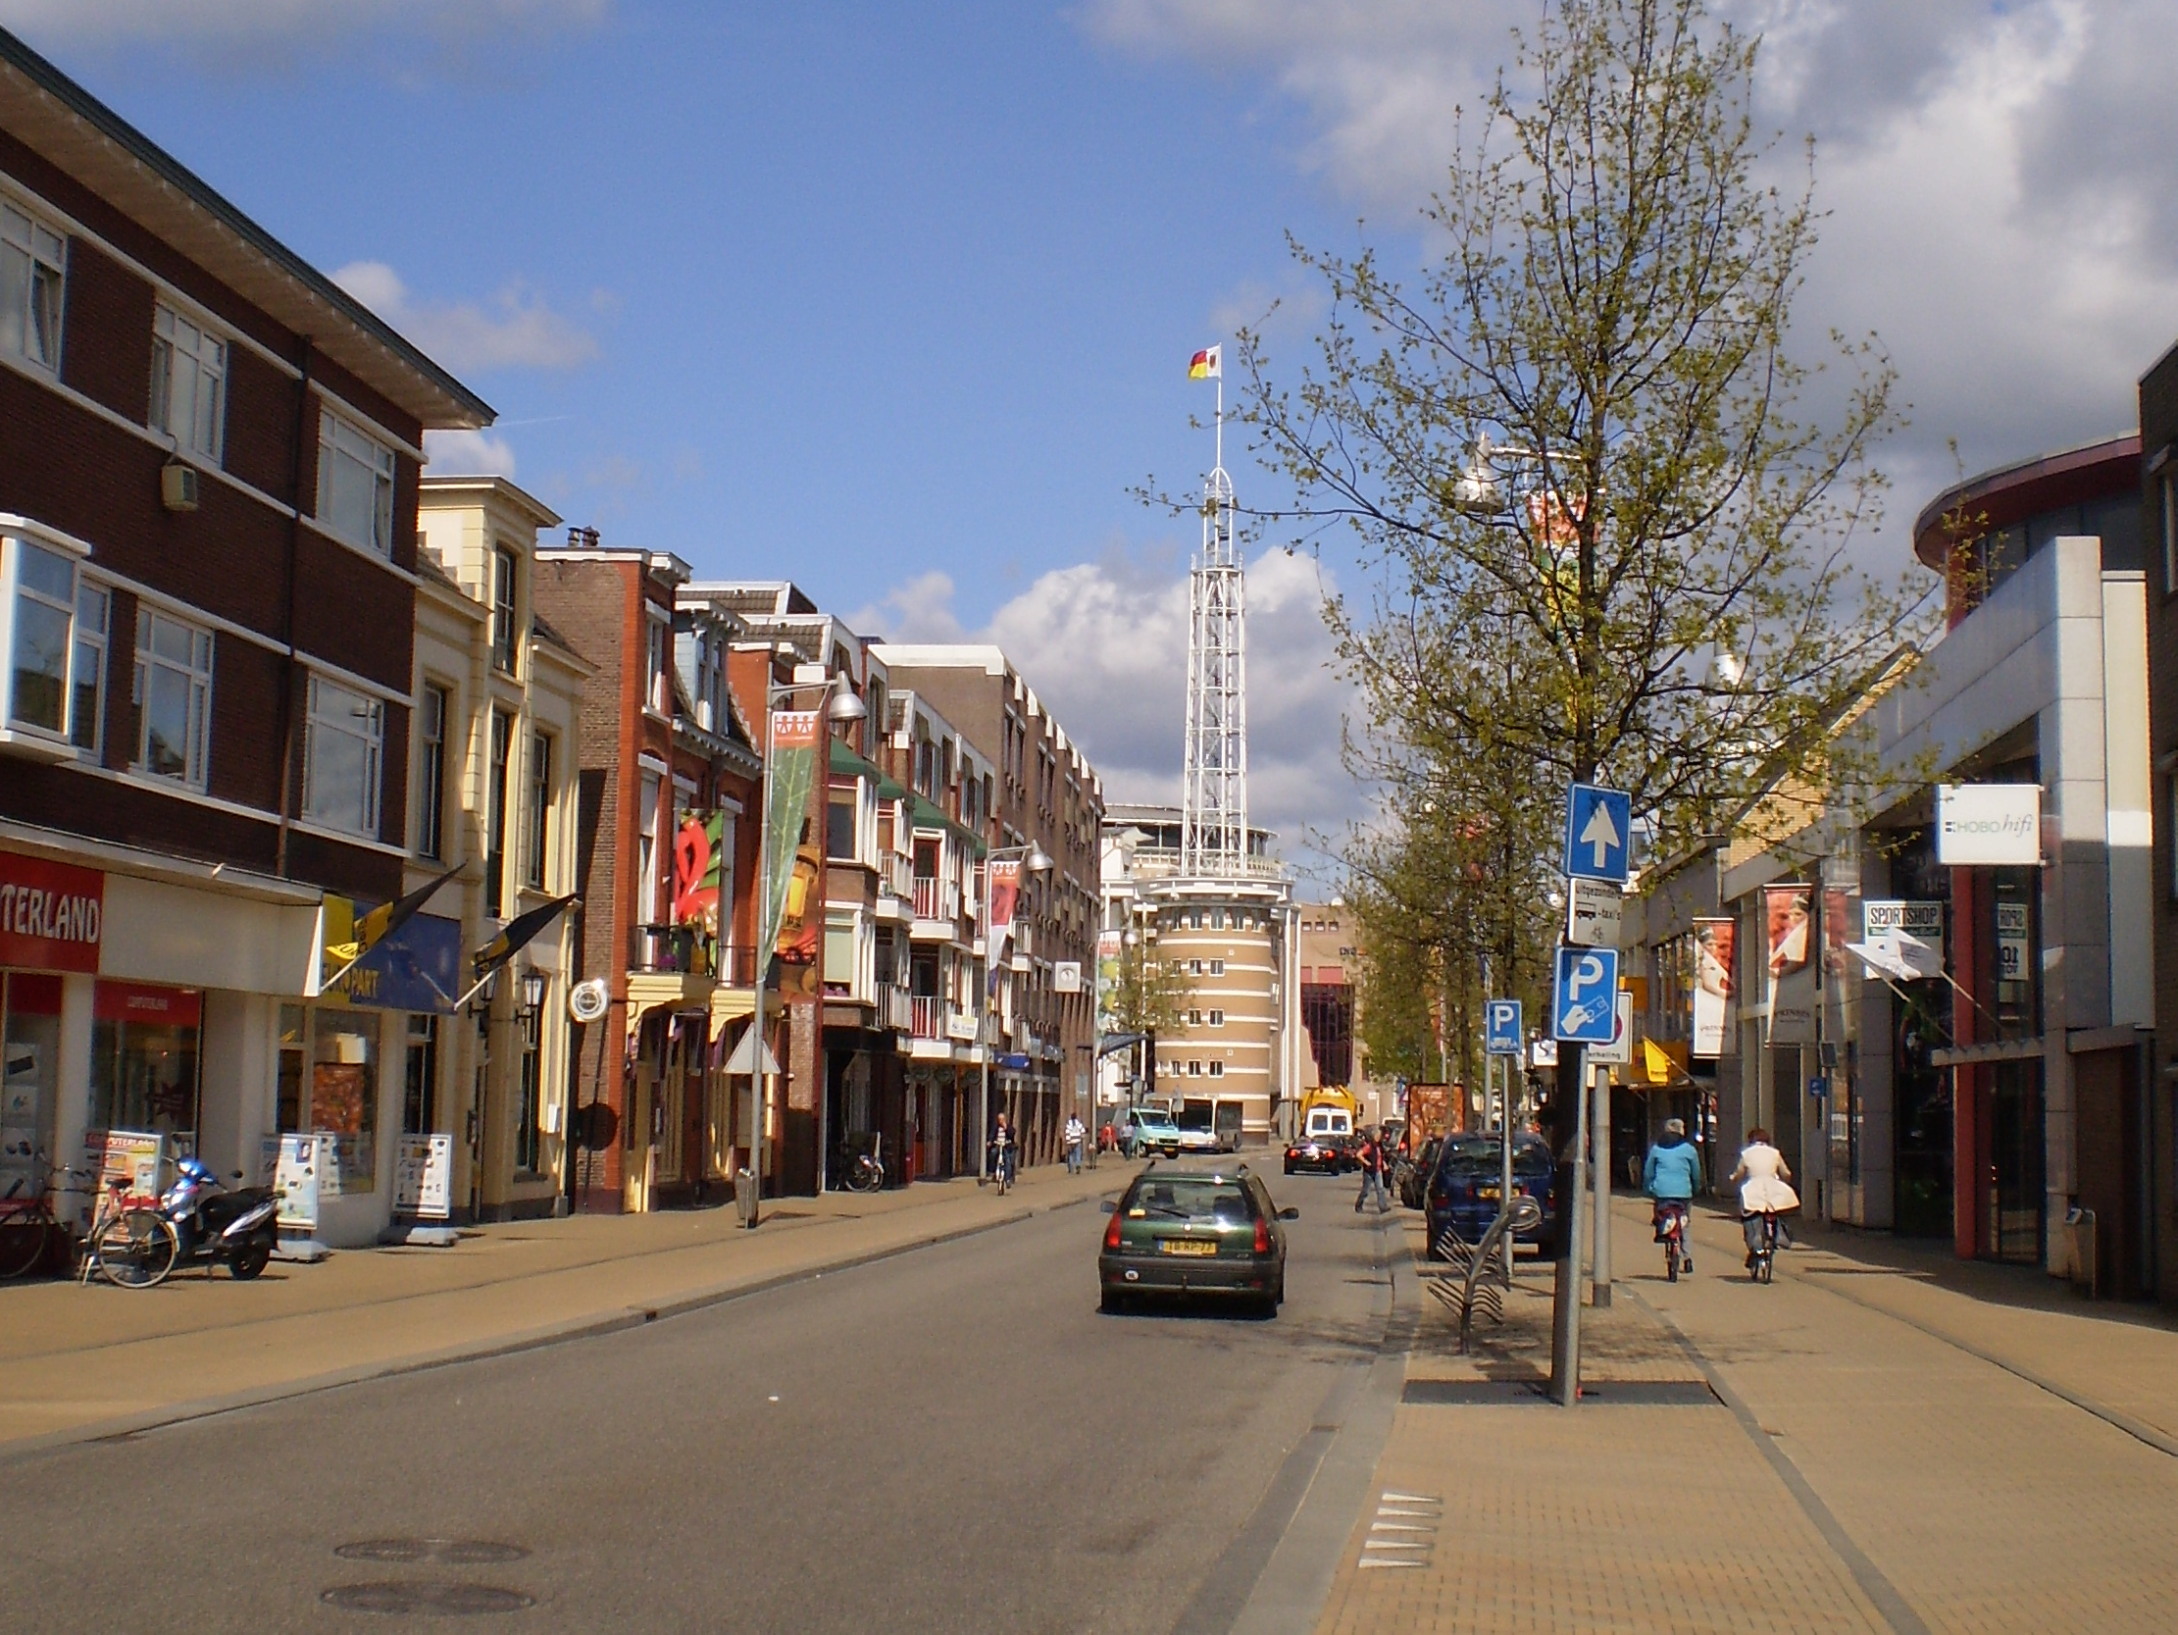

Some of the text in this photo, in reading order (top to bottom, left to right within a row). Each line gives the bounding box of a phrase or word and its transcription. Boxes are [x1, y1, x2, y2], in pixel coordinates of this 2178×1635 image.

[1957, 813, 2033, 838] HOBO hifi
[1, 884, 100, 944] TERLAND
[1870, 906, 1937, 925] SPORTSHOP
[1569, 955, 1604, 1001] P
[1494, 1005, 1514, 1032] P
